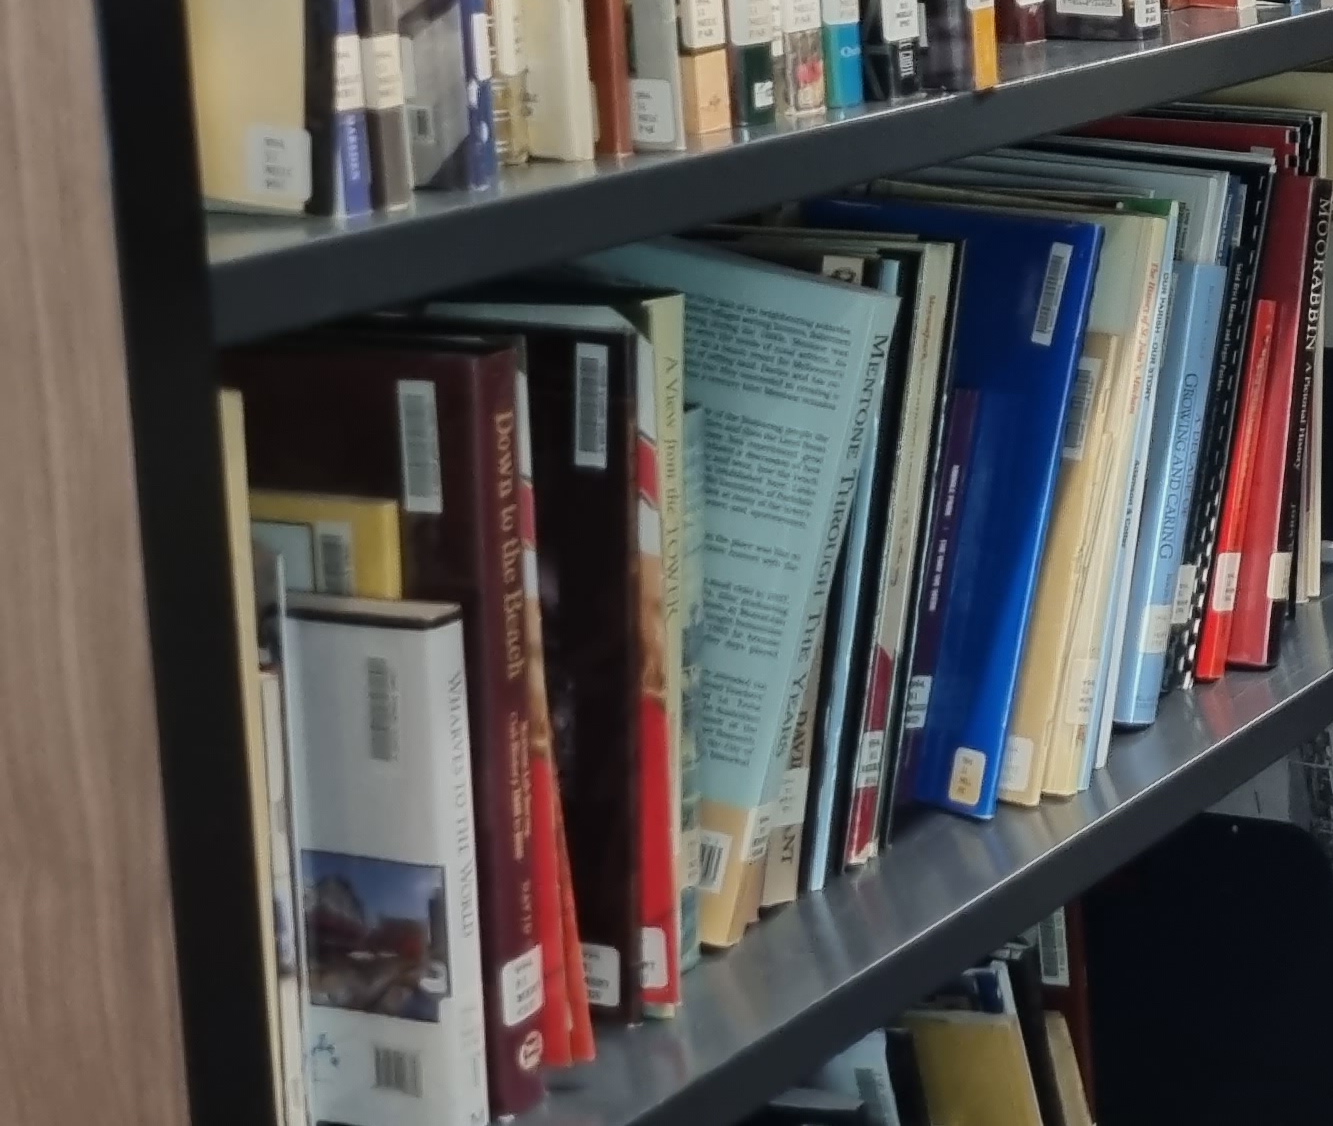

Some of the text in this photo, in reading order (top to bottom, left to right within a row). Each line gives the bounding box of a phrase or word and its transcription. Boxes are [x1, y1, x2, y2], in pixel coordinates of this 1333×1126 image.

[1149, 262, 1158, 278] The
[1304, 198, 1330, 351] MOORABBIN
[1143, 272, 1169, 401] OUR PARISH OUR STORY
[846, 335, 890, 460] MENTONE
[1292, 362, 1312, 469] A Pictorial History
[662, 355, 682, 622] A View from the TOWER
[1157, 372, 1199, 560] GROWING AND CARING
[1180, 497, 1189, 516] OF
[1183, 430, 1200, 491] DECADE
[494, 409, 525, 680] Down to the Beach
[812, 468, 858, 598] THROUGH
[798, 613, 822, 664] THE
[454, 782, 467, 808] TO
[456, 816, 470, 857] THE
